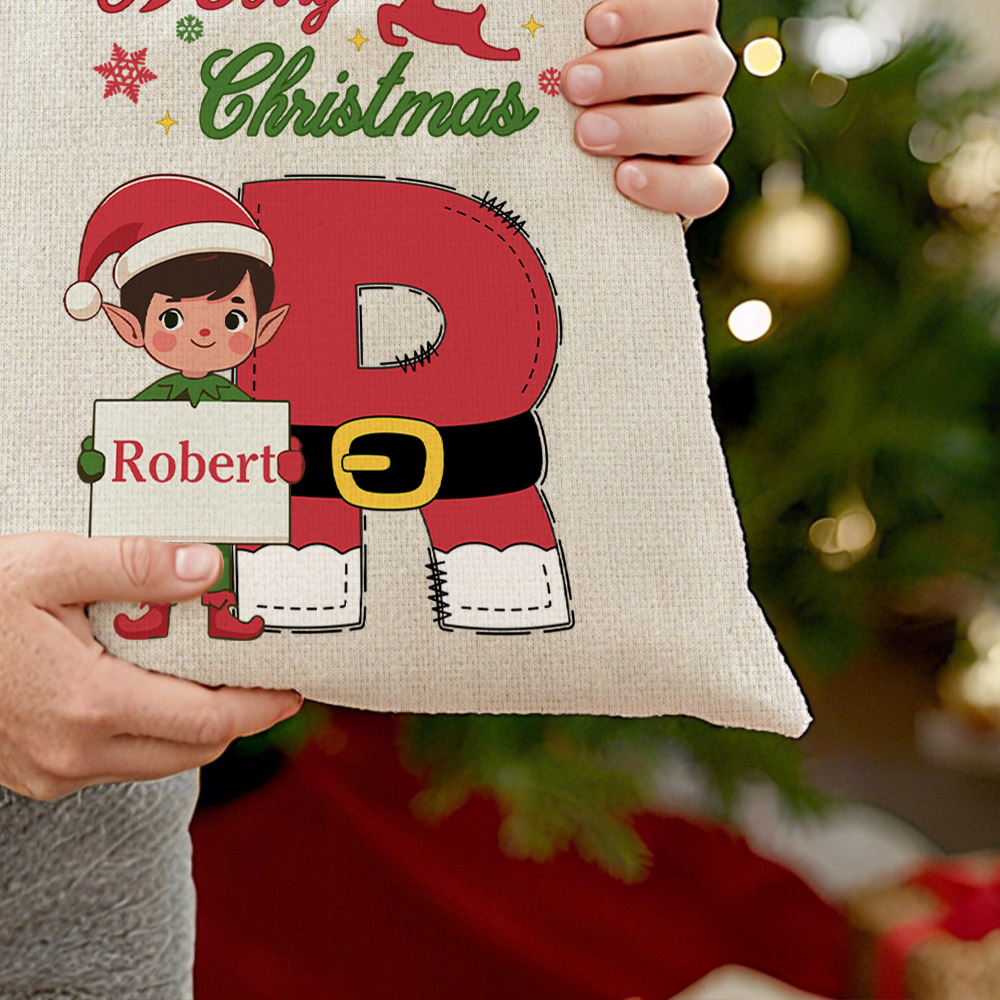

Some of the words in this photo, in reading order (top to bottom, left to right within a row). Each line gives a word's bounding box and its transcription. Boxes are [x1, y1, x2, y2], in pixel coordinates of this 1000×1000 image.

[199, 42, 539, 140] Christmas
[234, 175, 574, 634] R
[111, 439, 277, 484] Robert
